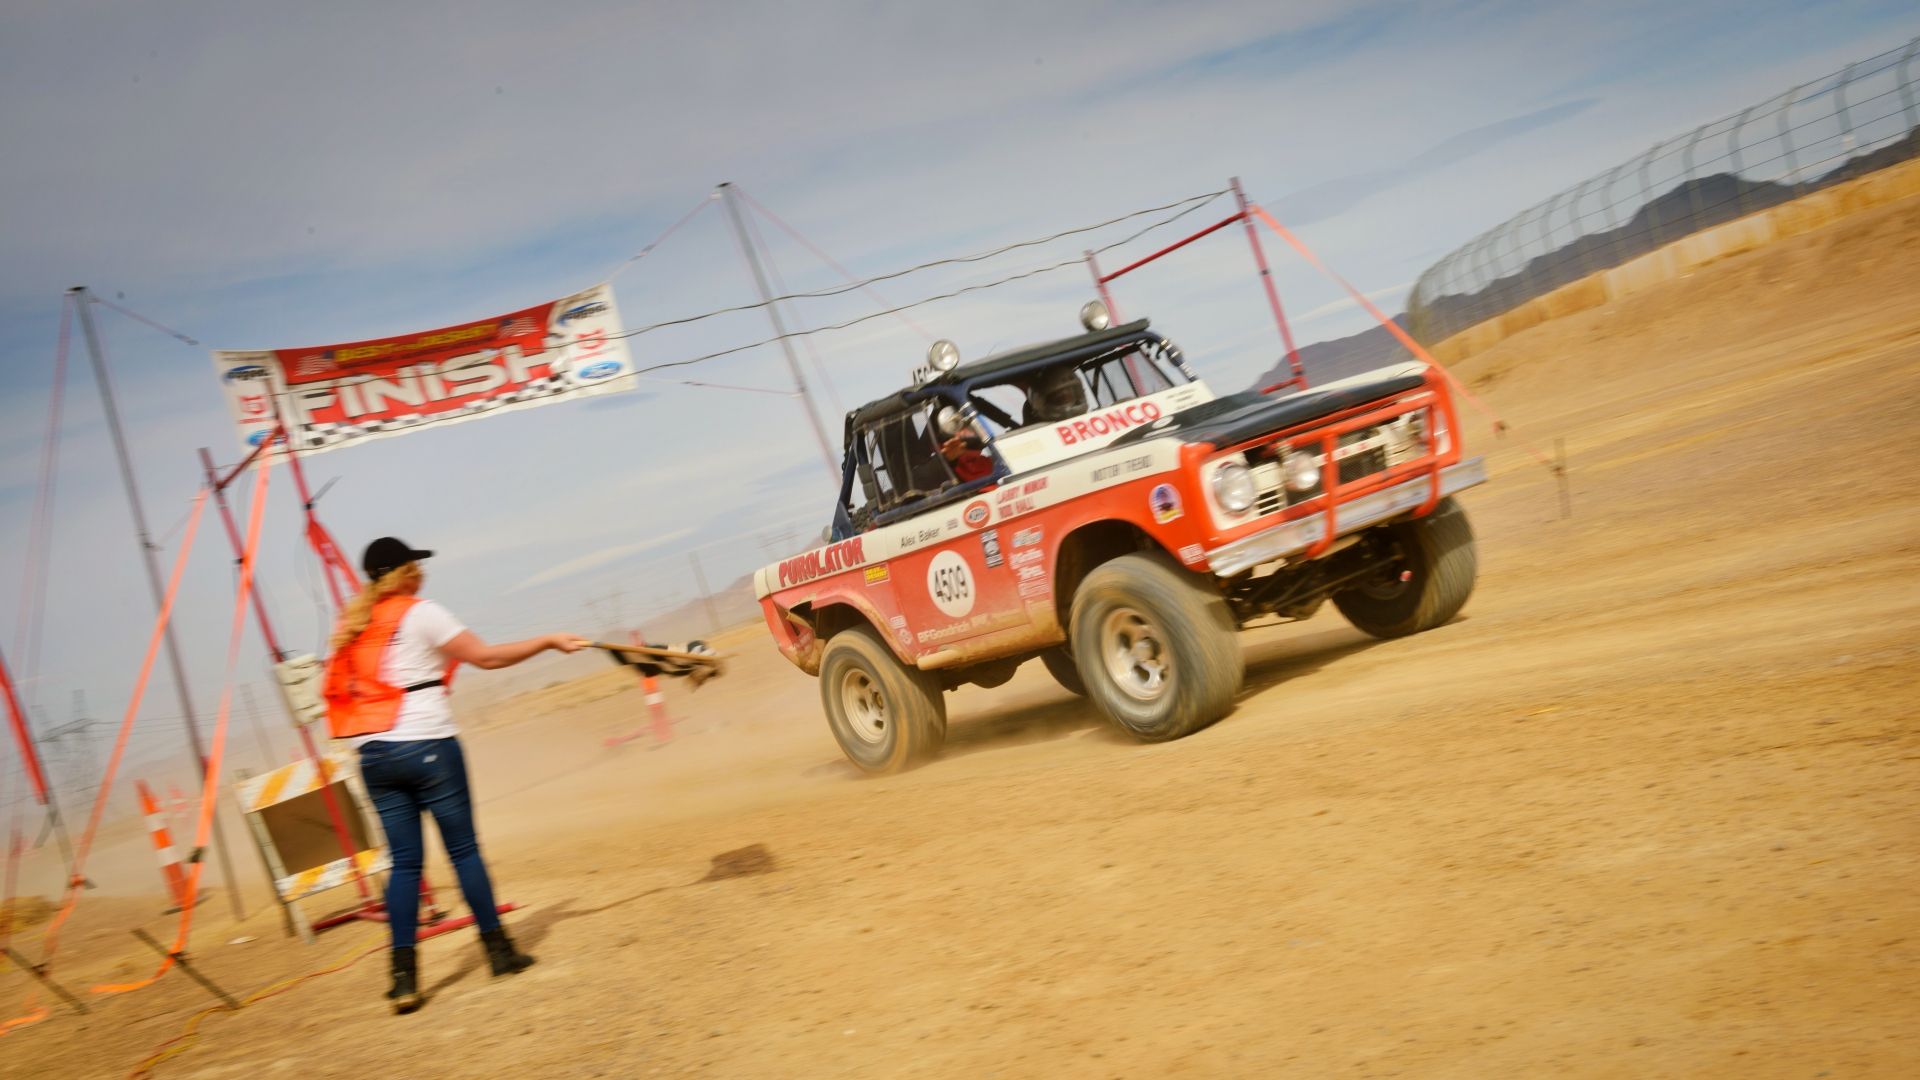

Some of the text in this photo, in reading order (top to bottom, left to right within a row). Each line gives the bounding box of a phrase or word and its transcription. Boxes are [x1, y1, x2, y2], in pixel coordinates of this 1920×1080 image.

[287, 334, 568, 426] FINISH
[1056, 401, 1161, 446] BRONCO
[900, 527, 941, 549] Alex Baker
[778, 538, 865, 587] PUROLATOR
[934, 564, 969, 604] 4509
[916, 621, 970, 645] BFGoodrich
